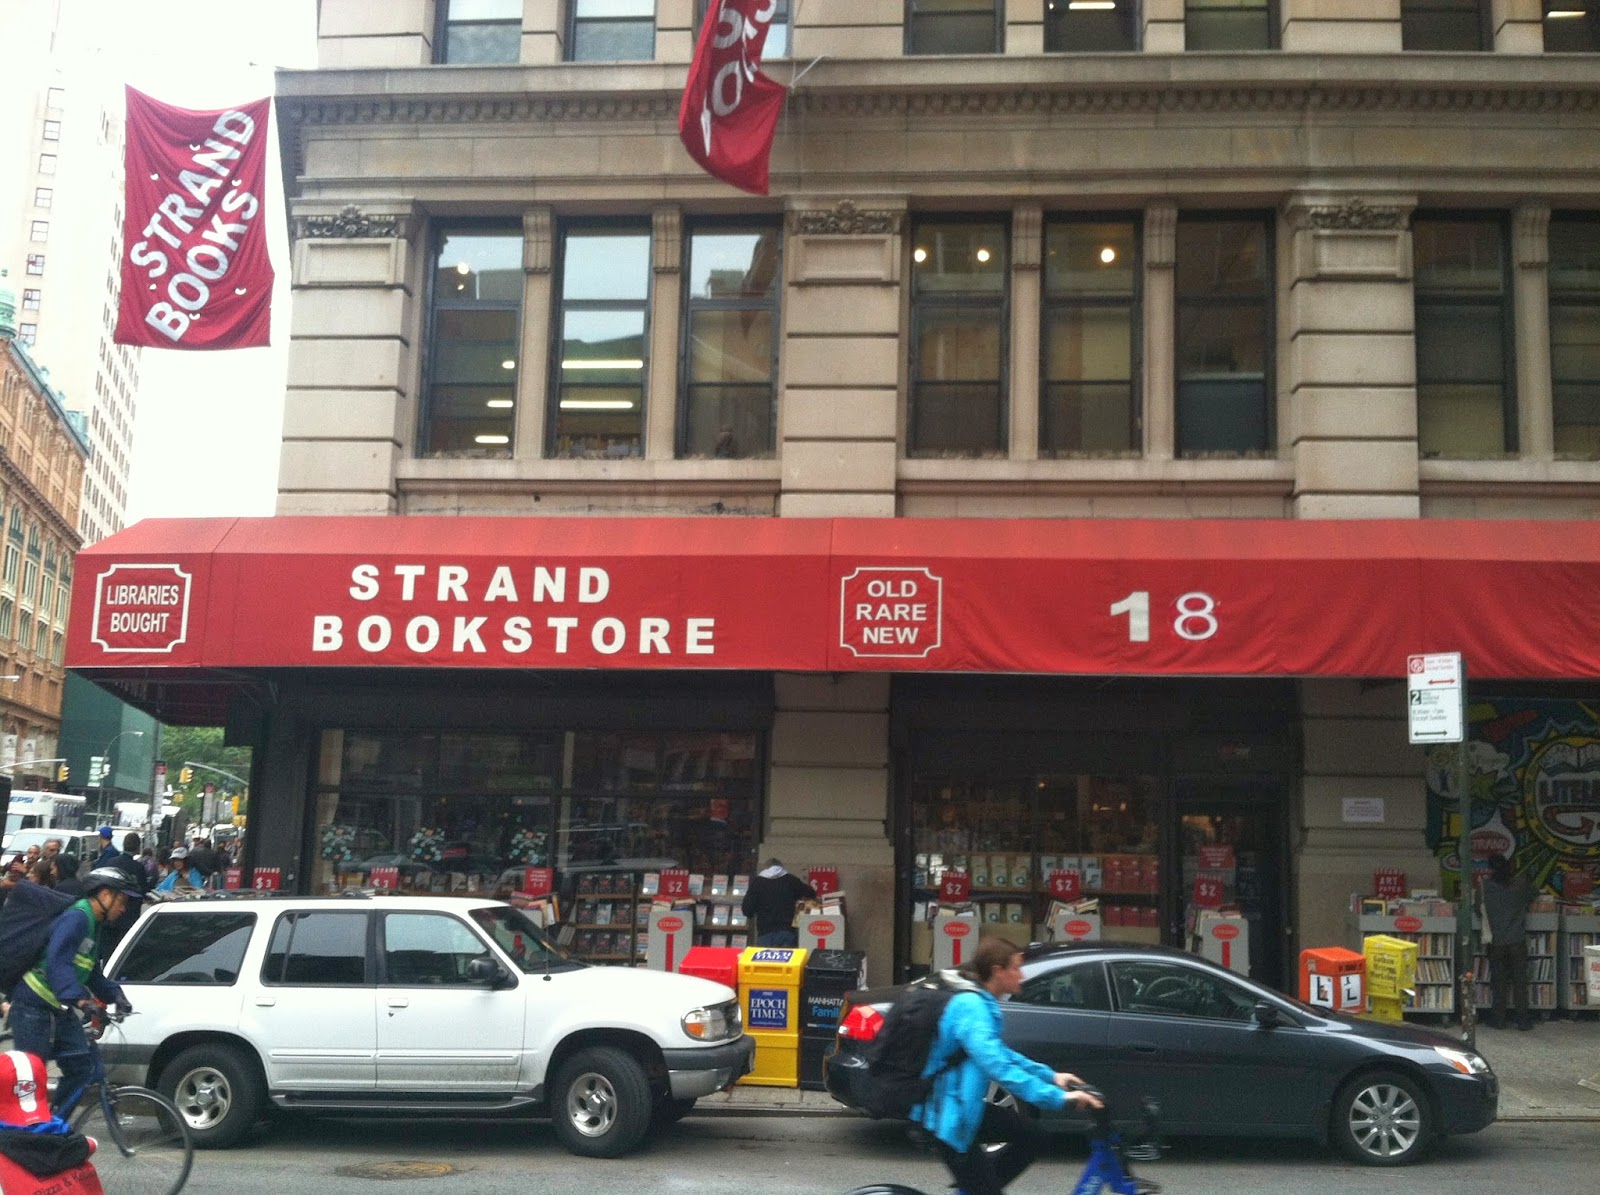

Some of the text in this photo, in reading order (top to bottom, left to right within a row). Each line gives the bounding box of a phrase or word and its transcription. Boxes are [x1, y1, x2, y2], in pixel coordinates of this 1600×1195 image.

[130, 110, 255, 278] STRAND
[144, 188, 259, 342] BOOKS
[349, 564, 611, 603] STRAND
[867, 580, 917, 597] OLD
[106, 585, 179, 605] LIBRARIES
[856, 603, 927, 621] RARE
[1110, 591, 1218, 642] 18
[110, 612, 169, 633] BOUGHT
[312, 615, 715, 654] BOOKSTORE
[863, 627, 919, 644] NEW
[1411, 691, 1420, 705] 2
[946, 883, 962, 895] $2
[1055, 879, 1072, 892] $2
[1200, 883, 1217, 896] $2
[751, 998, 786, 1009] EPOCH
[808, 996, 844, 1007] MANHATTA
[751, 1008, 786, 1019] TIMES
[812, 1006, 839, 1018] Famil
